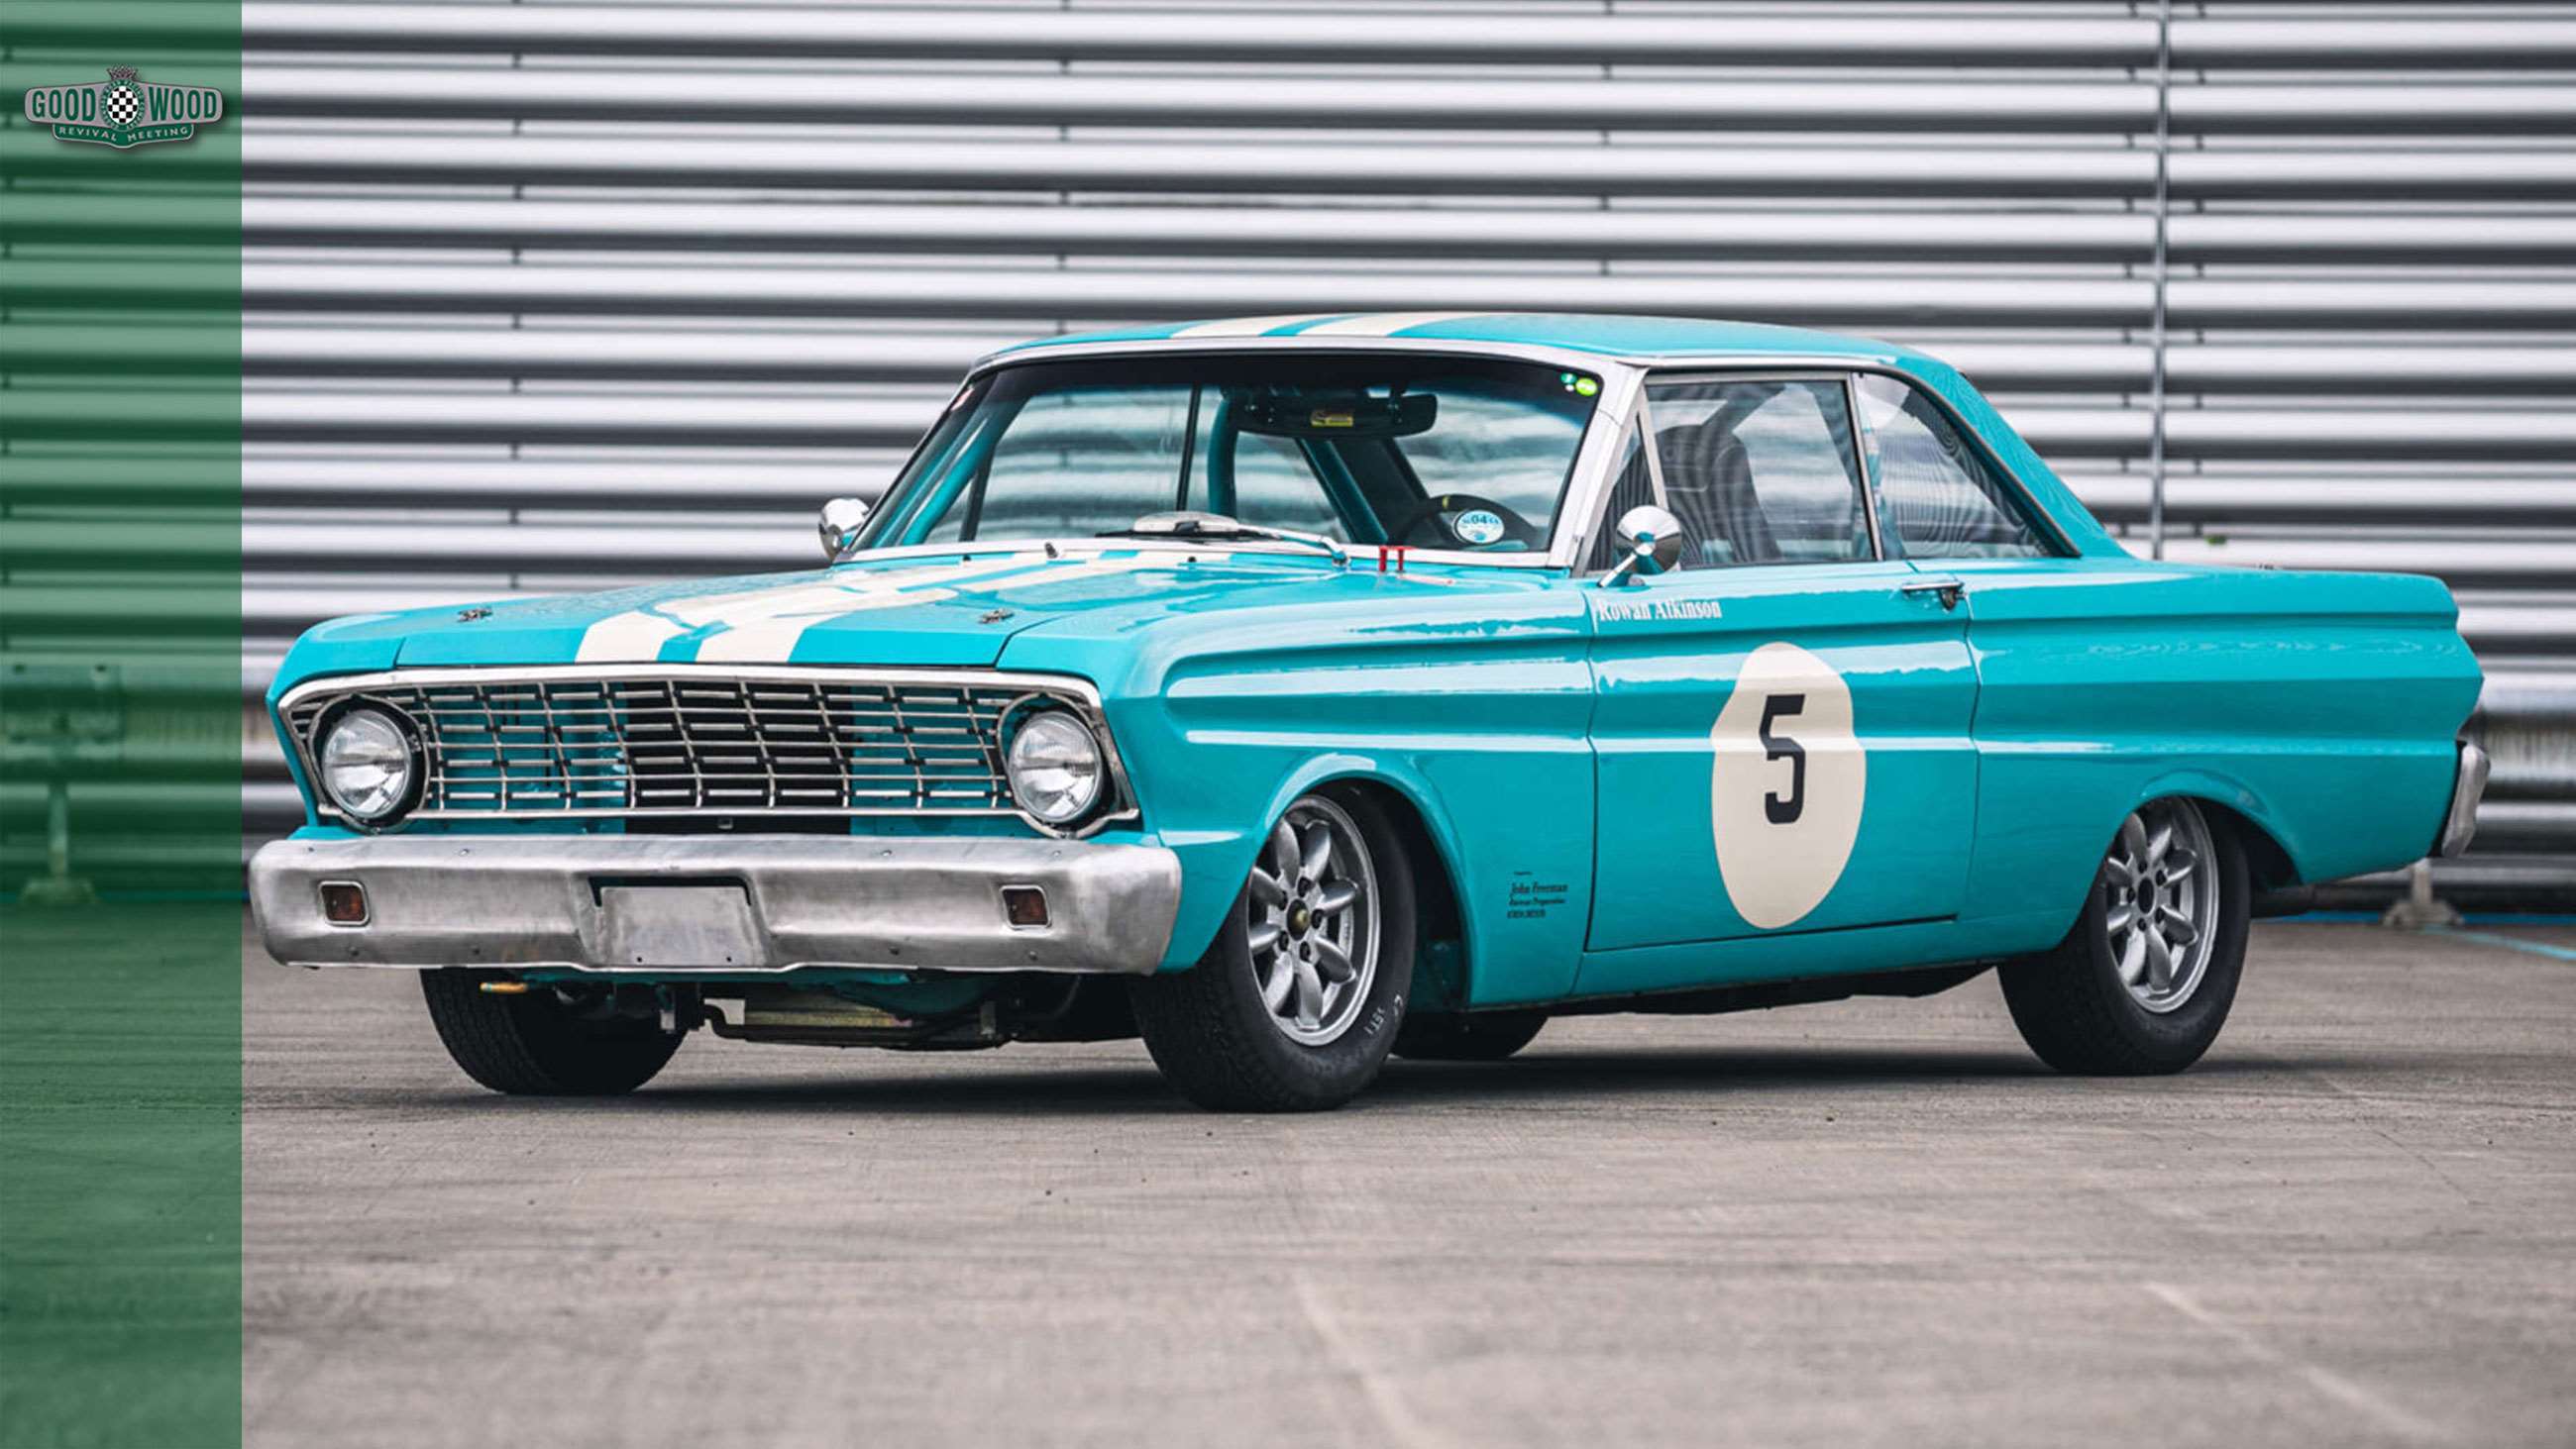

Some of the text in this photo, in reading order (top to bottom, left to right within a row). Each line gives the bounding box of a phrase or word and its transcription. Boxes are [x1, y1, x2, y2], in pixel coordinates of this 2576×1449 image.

[1597, 598, 1722, 621] Rowan Atkinson
[1759, 693, 1806, 825] 5
